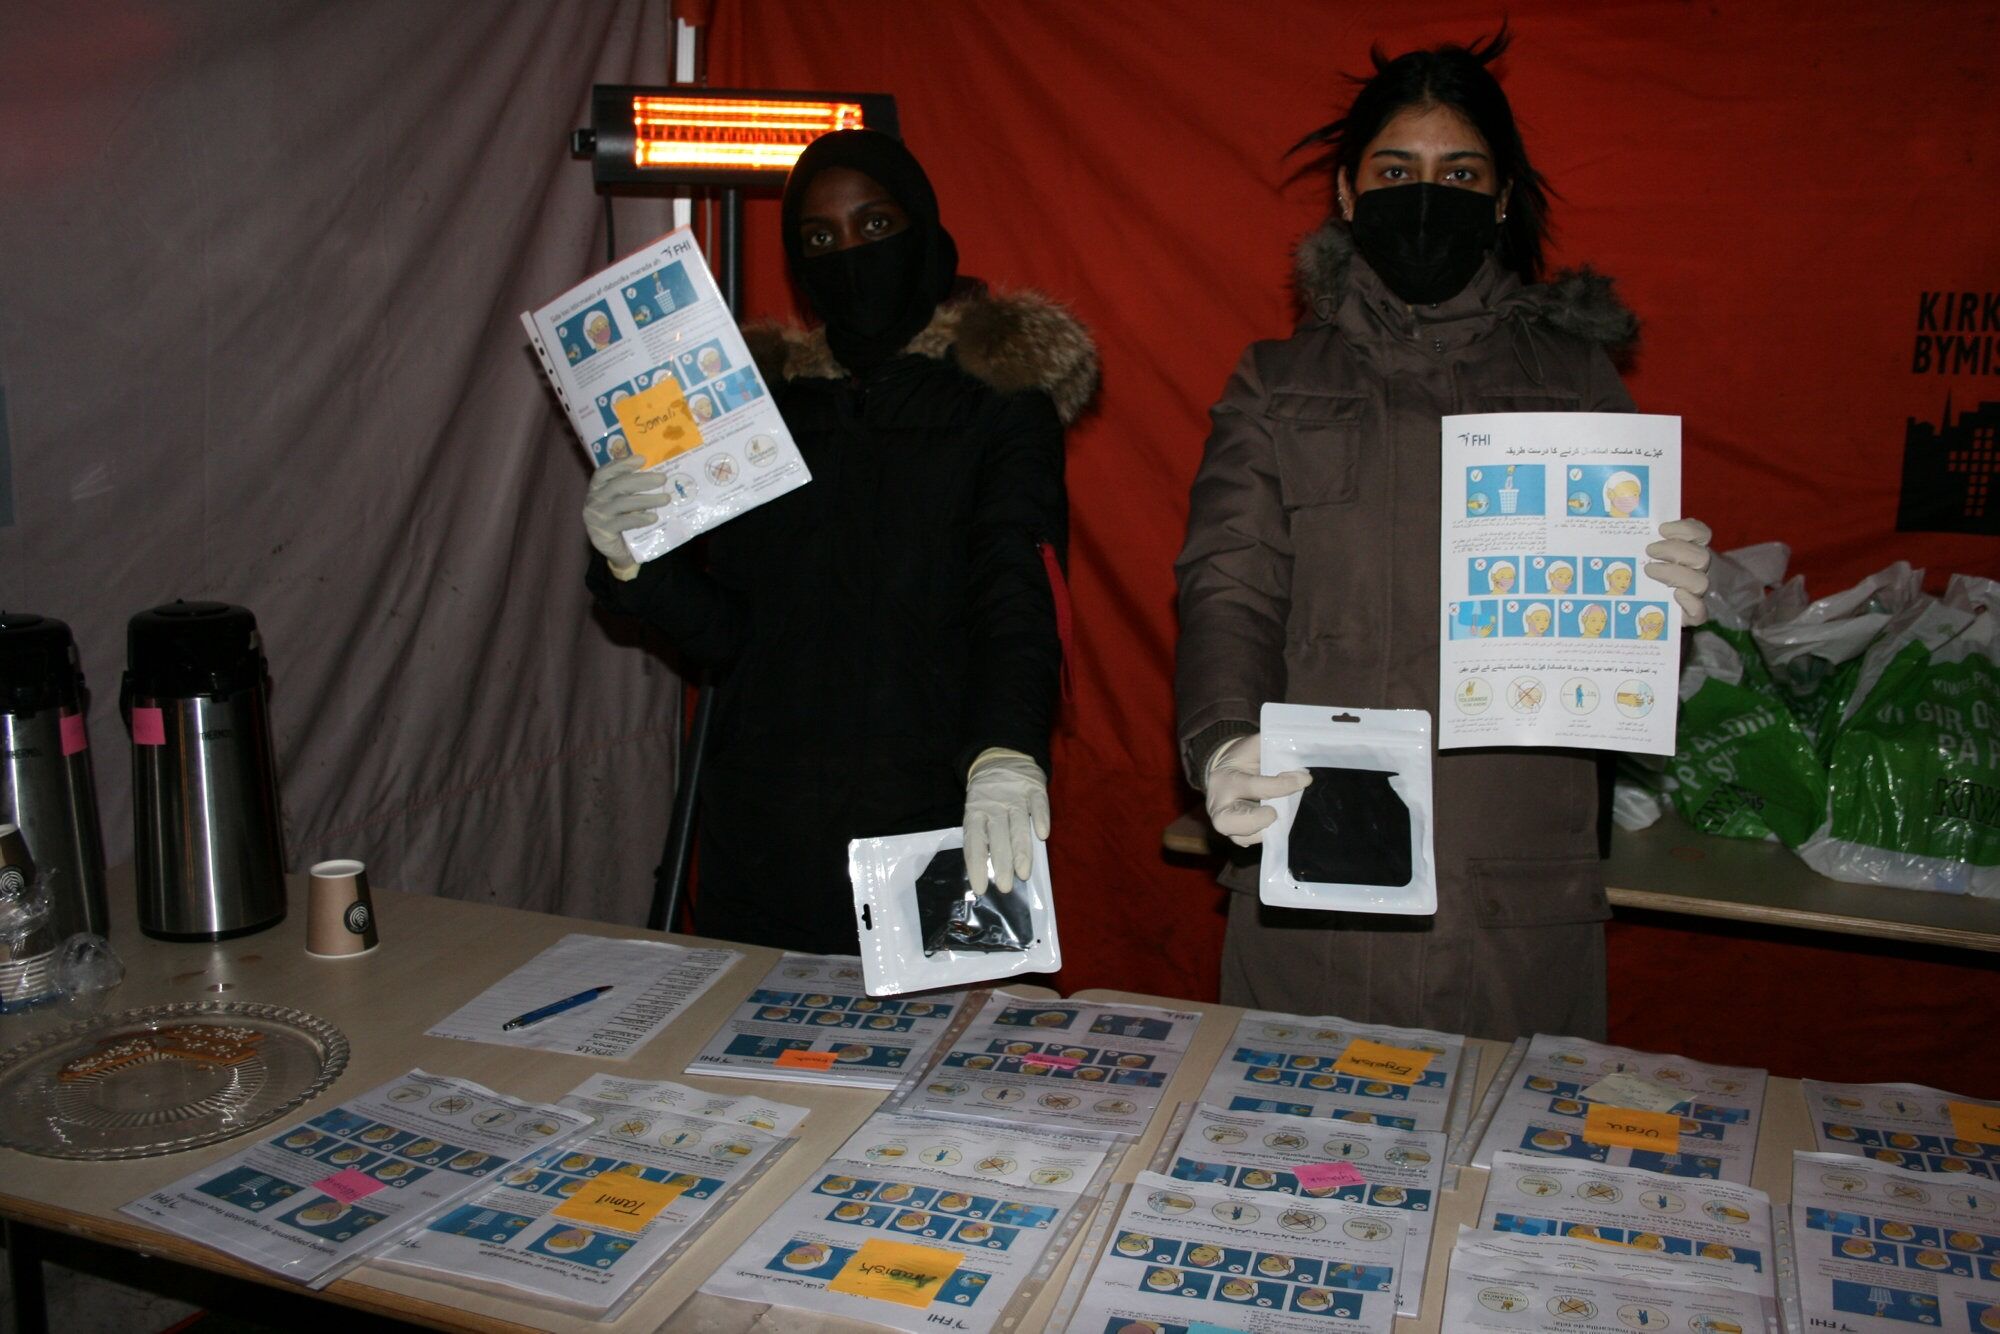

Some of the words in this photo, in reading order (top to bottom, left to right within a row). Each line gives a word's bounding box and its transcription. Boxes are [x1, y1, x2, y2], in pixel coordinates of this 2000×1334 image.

[673, 240, 692, 256] FHI
[1918, 291, 2000, 332] KIRK
[634, 407, 677, 434] Somali
[1472, 434, 1491, 446] FHI
[1351, 1056, 1412, 1076] Engelsk
[1606, 1121, 1660, 1139] Urdu
[595, 1193, 647, 1217] Tamil
[927, 1313, 954, 1327] FHI
[1809, 1317, 1837, 1329] FHI
